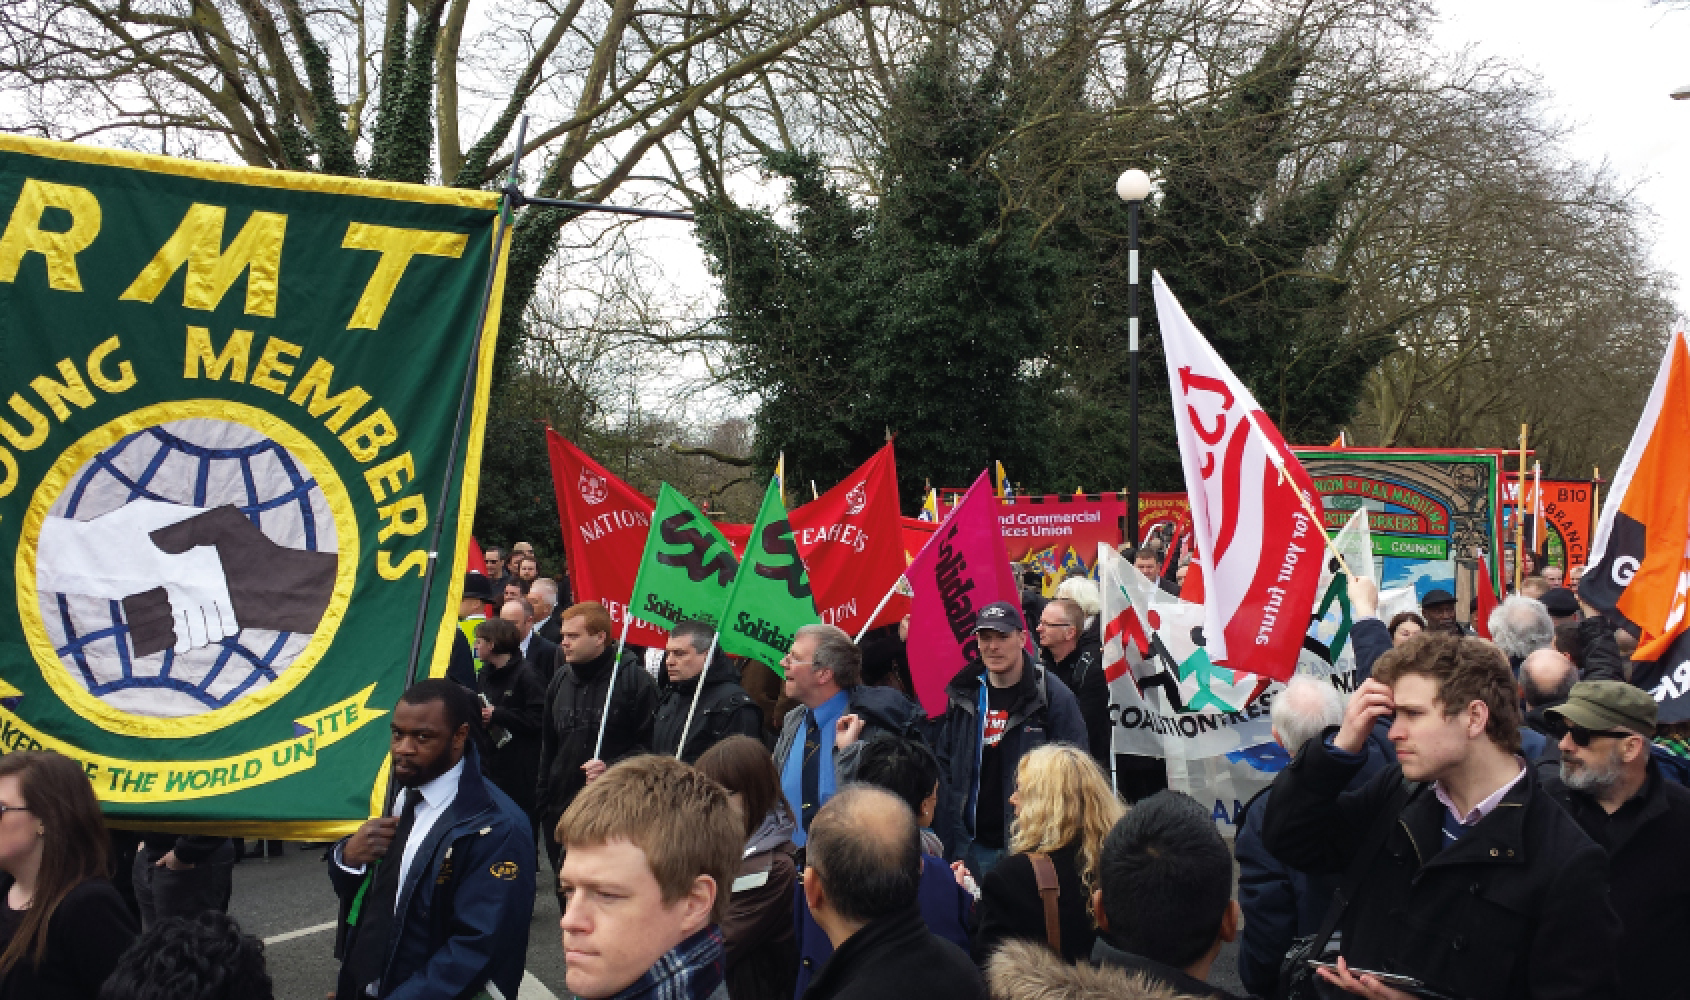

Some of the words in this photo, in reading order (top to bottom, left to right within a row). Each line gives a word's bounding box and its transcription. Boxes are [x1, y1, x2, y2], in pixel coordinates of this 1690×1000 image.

[0, 178, 470, 330] RMT
[183, 325, 428, 581] MEMBERS
[1362, 480, 1389, 499] RAIL
[1558, 488, 1587, 503] B10
[1017, 510, 1101, 525] Commercial
[1368, 514, 1419, 531] ORKERS
[1031, 525, 1073, 537] Union
[1545, 502, 1583, 565] BRANCH
[1391, 541, 1443, 556] COUNCIL
[108, 767, 159, 793] THE
[164, 758, 262, 793] WORLD
